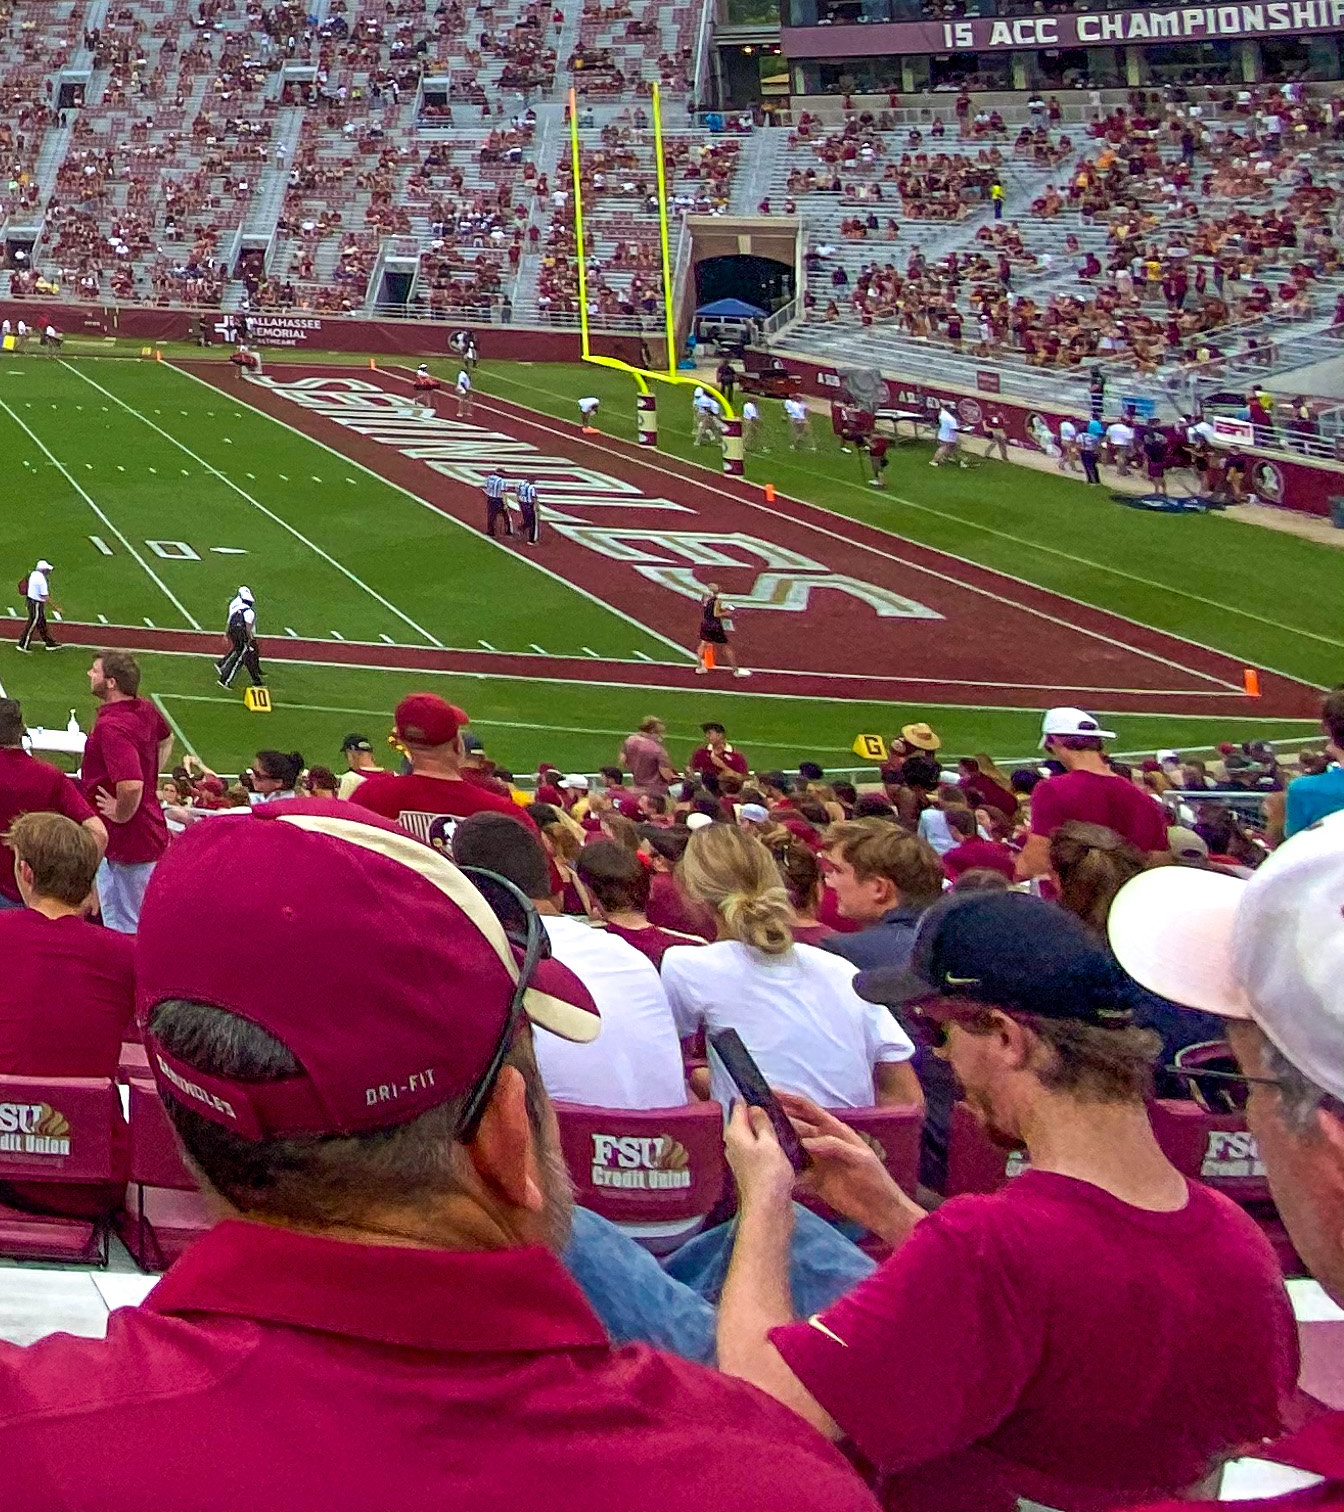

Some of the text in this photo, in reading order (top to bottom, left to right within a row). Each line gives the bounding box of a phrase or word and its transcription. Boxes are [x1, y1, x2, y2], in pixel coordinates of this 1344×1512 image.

[989, 18, 1059, 46] ACC
[250, 688, 269, 707] 10
[865, 736, 883, 755] G
[365, 1067, 436, 1106] DRI-FIT
[24, 1135, 71, 1157] Union
[592, 1133, 665, 1170] FSU
[592, 1166, 691, 1190] Credit Union
